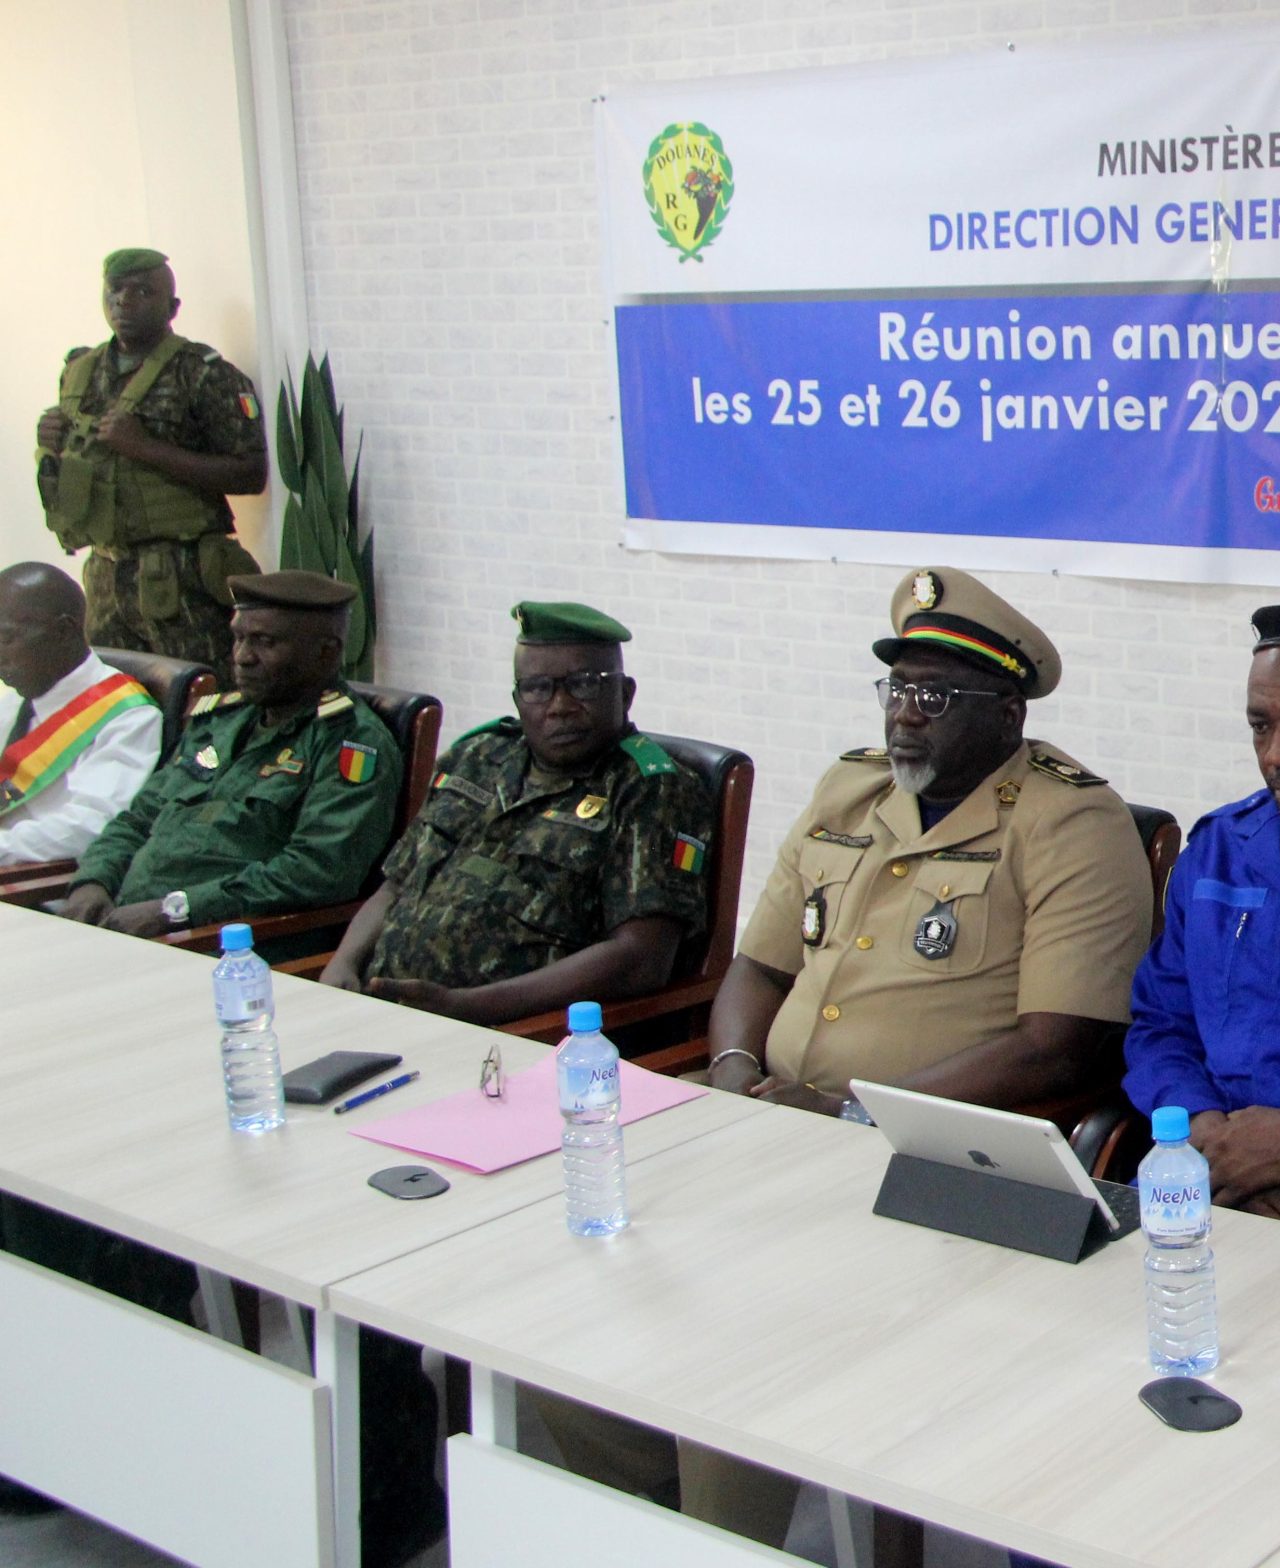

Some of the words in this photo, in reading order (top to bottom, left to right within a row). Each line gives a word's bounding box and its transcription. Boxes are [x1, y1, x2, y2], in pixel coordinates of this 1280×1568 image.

[656, 143, 717, 170] DOUANES
[665, 192, 678, 210] R
[674, 213, 688, 231] G
[928, 204, 1139, 252] DIRECTION
[879, 309, 1091, 361] Réunion
[692, 377, 752, 425] les
[767, 378, 822, 426] 25
[839, 384, 881, 427] et
[898, 379, 961, 429] 26
[979, 378, 1168, 442] janvier
[1151, 1186, 1201, 1205] NeeNe
